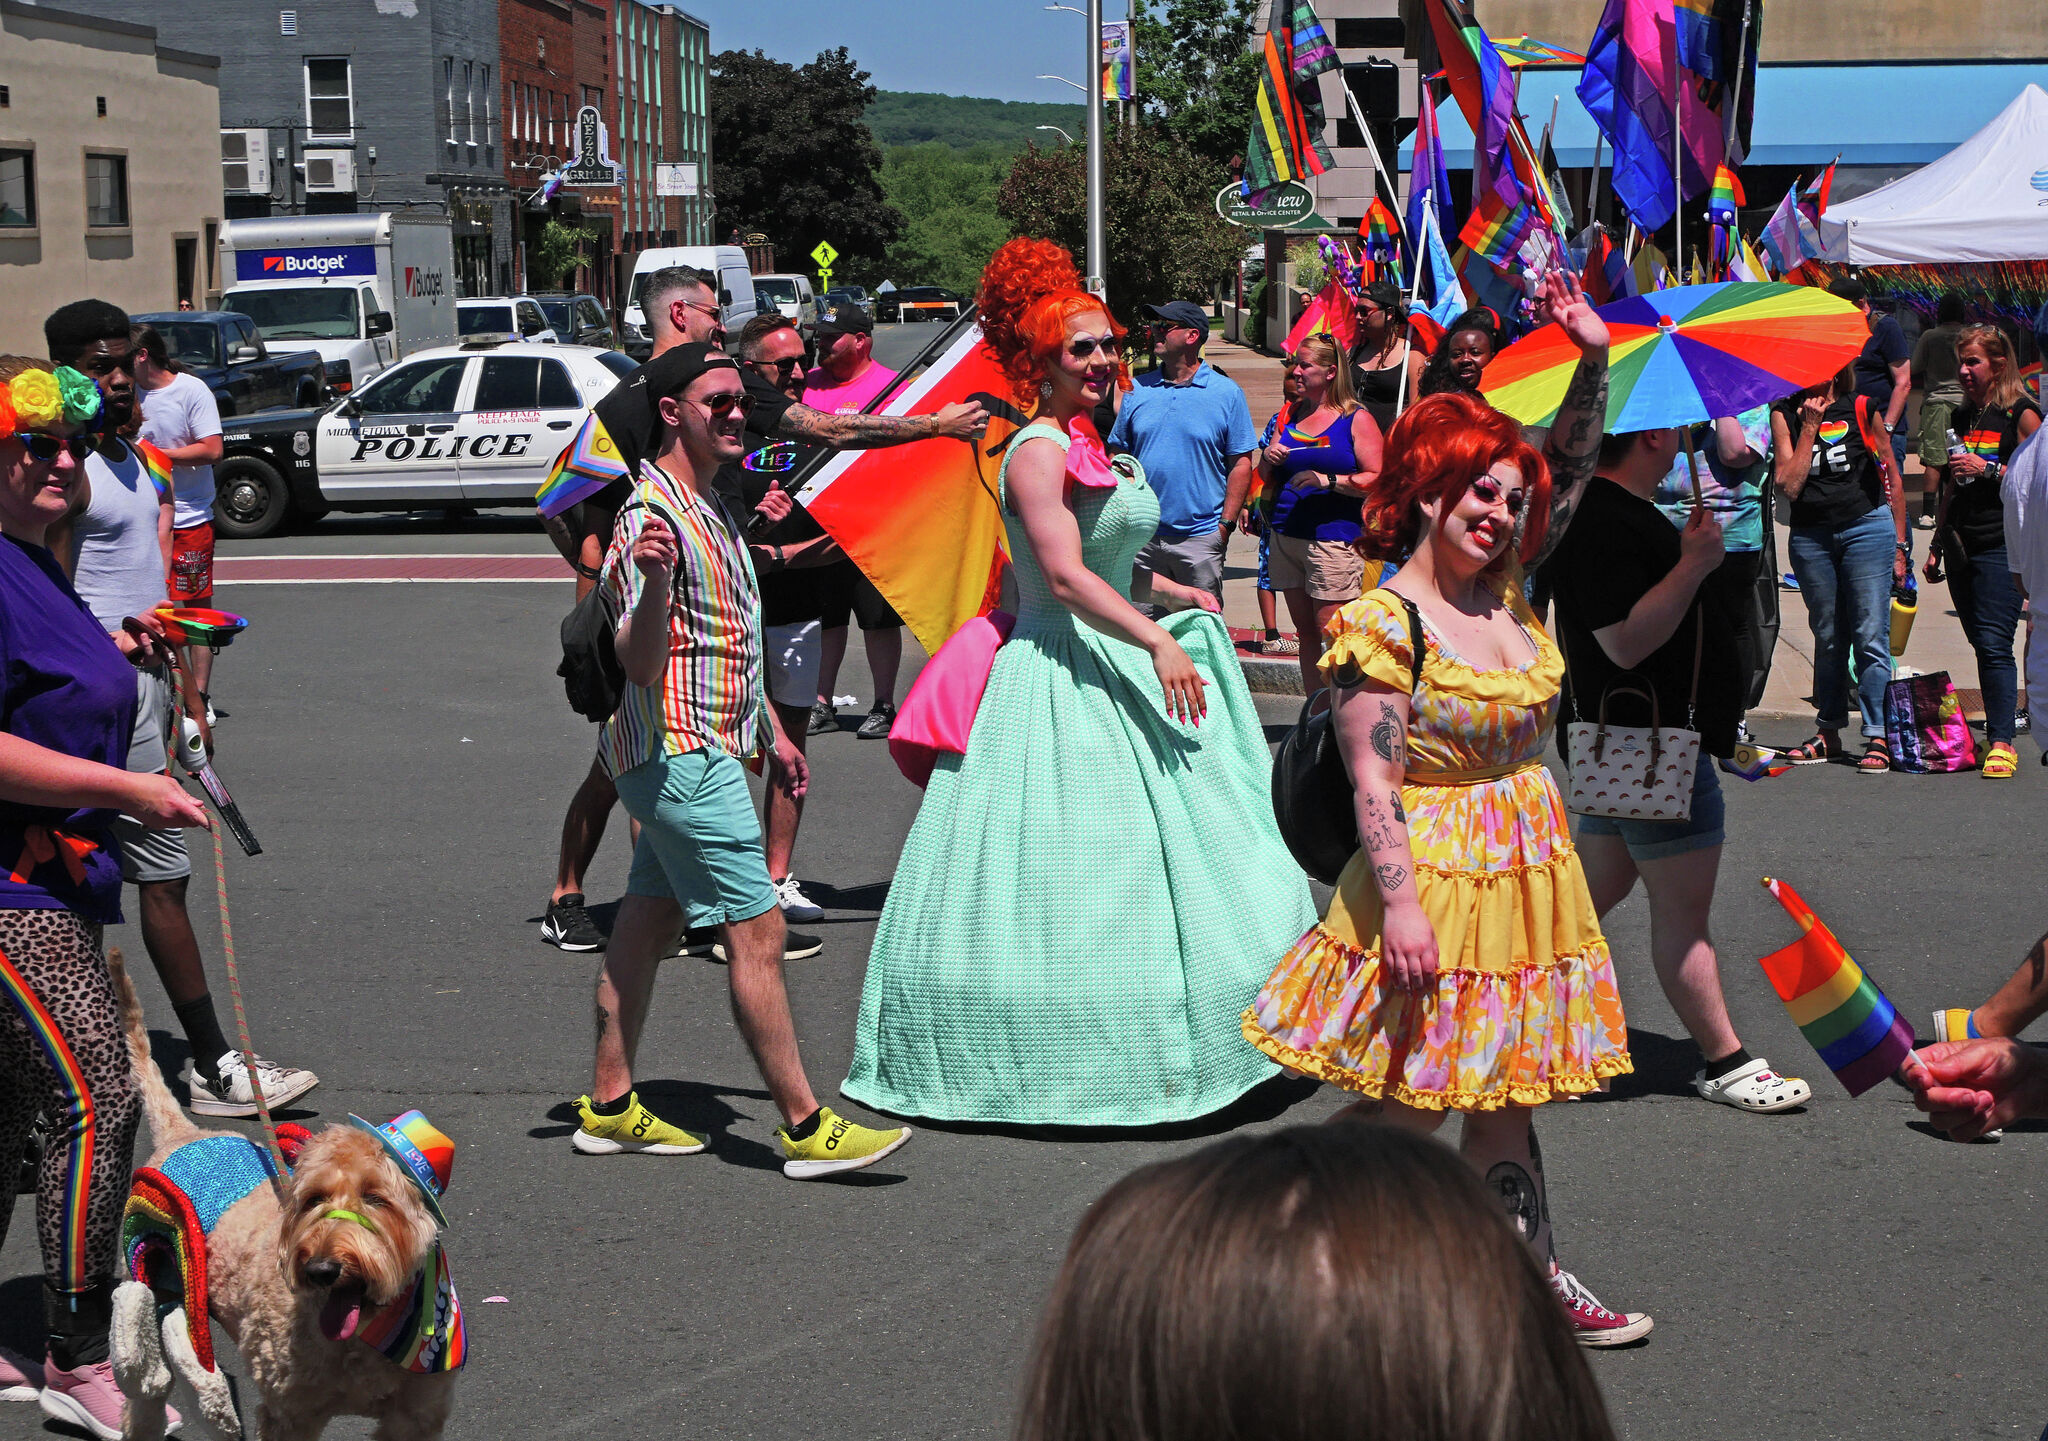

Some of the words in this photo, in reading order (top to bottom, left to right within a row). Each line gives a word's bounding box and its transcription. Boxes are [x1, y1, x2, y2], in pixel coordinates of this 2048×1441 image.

[582, 114, 595, 167] MEZZO
[569, 170, 612, 180] GRILLE
[286, 255, 345, 274] Budget
[415, 266, 443, 305] Budget
[477, 411, 507, 419] KEEP
[510, 410, 541, 418] BACK
[223, 433, 252, 442] PATROL
[326, 426, 403, 437] MIDDLETOWN
[350, 433, 533, 462] POLICE
[295, 459, 311, 468] 116
[632, 1109, 656, 1137] adi
